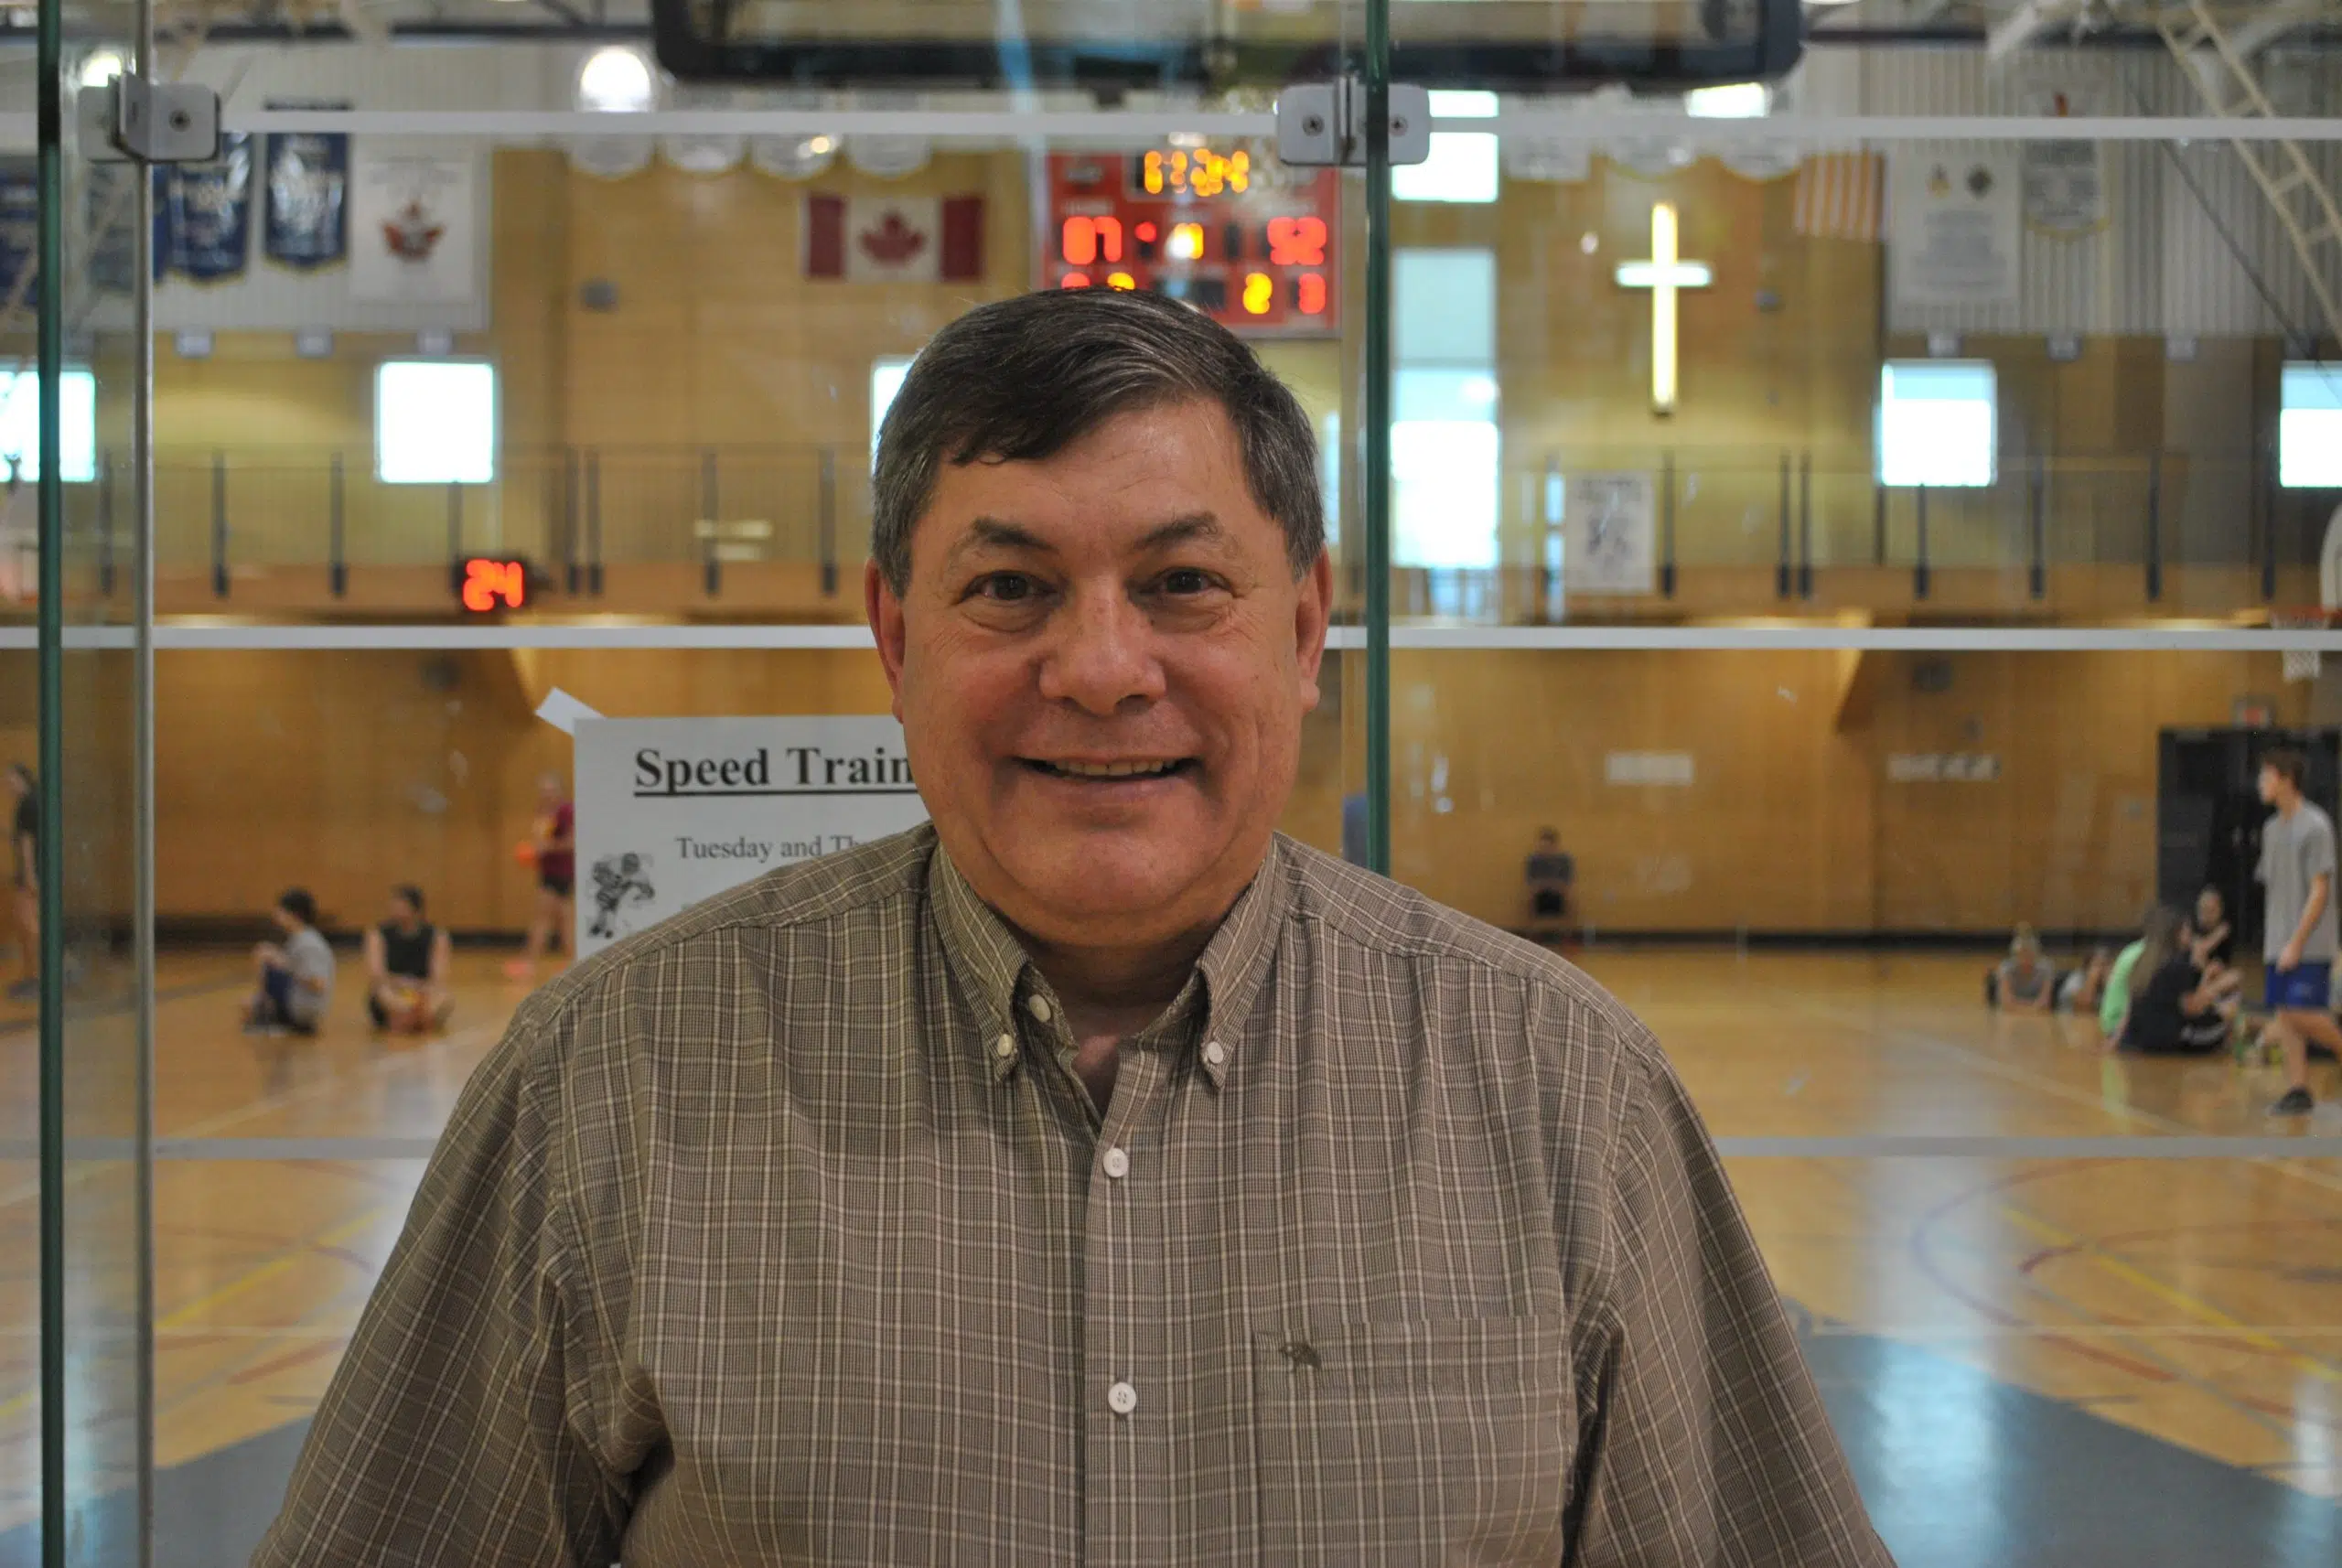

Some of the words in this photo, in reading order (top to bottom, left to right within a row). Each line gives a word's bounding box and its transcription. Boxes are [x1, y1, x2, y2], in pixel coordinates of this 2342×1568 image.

[463, 559, 523, 611] 24
[635, 746, 770, 794] Speed
[675, 836, 773, 864] Tuesday
[780, 834, 823, 858] and
